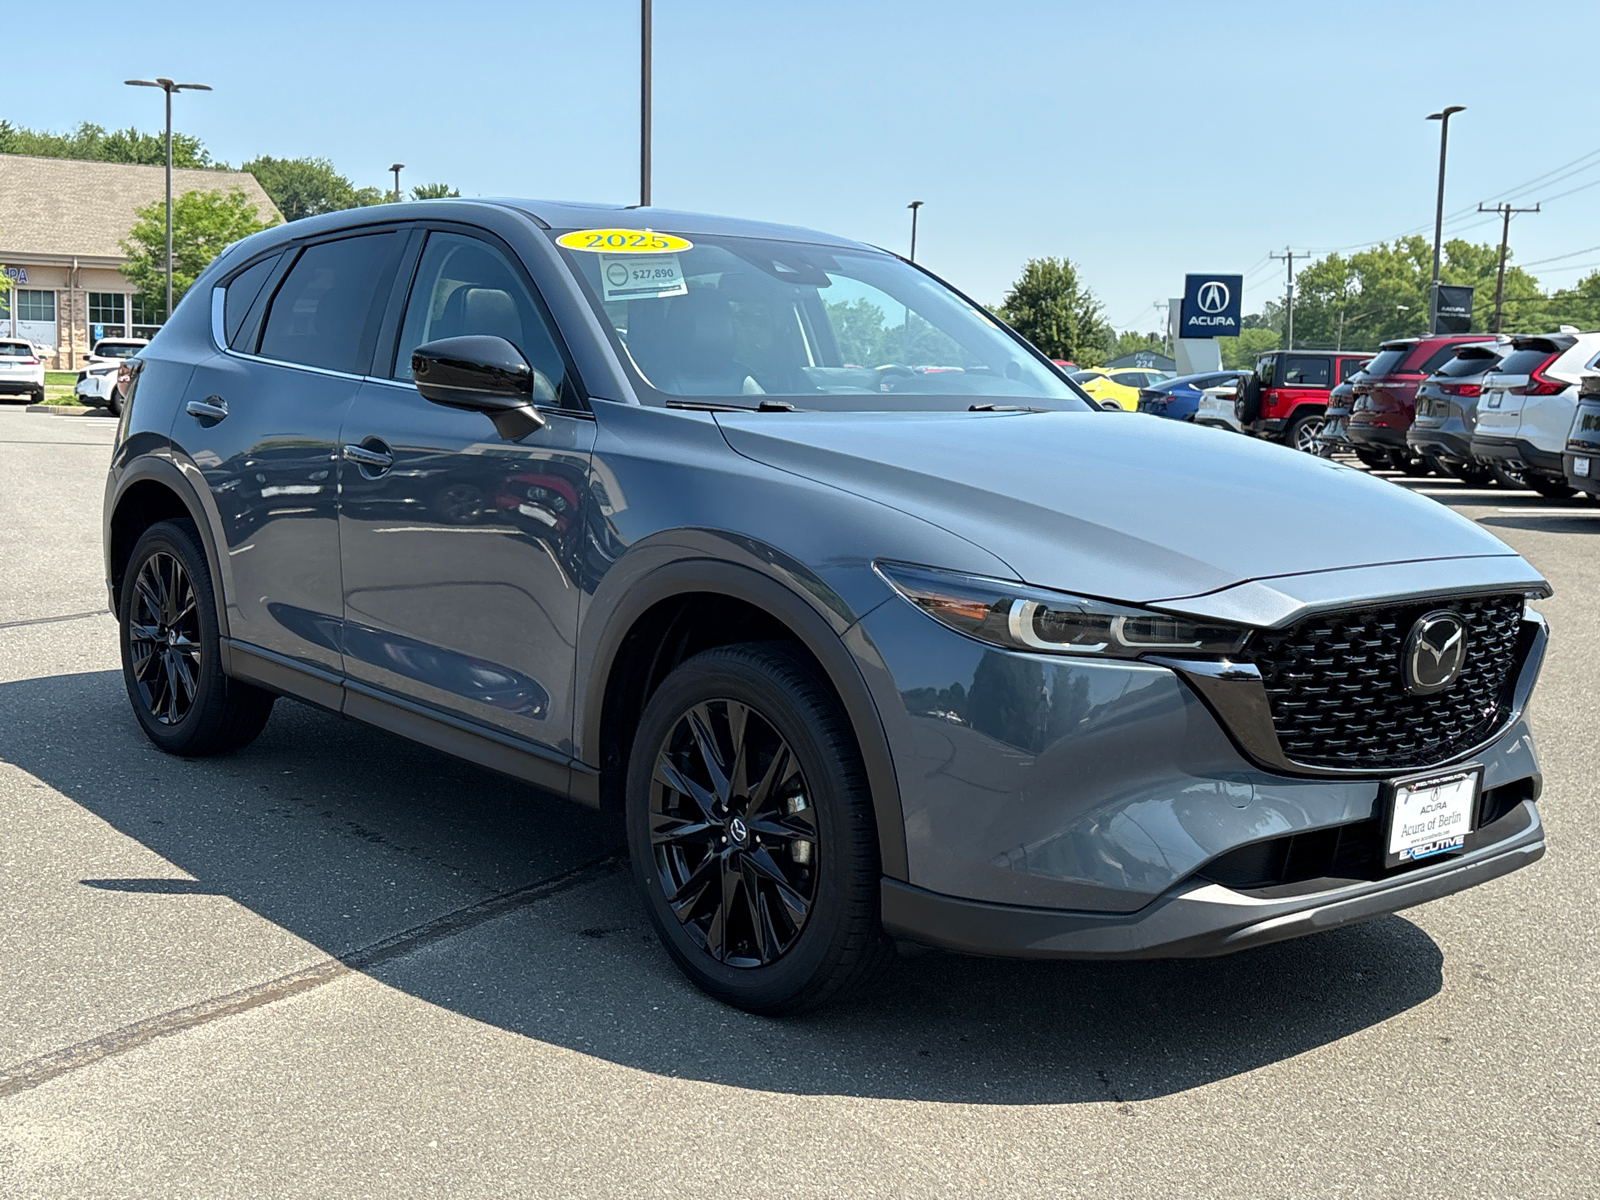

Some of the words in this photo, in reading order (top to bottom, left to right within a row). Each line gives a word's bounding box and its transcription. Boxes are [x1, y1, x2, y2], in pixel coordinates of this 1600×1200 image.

[584, 234, 669, 248] 2025
[632, 268, 674, 281] $27,890
[1188, 315, 1235, 326] ACURA
[1136, 360, 1153, 368] 224
[1420, 801, 1447, 815] ACURA
[1401, 823, 1425, 838] Acura
[1427, 817, 1436, 830] of
[1438, 811, 1462, 828] Berlin
[1399, 834, 1465, 860] EXECUTIVE
